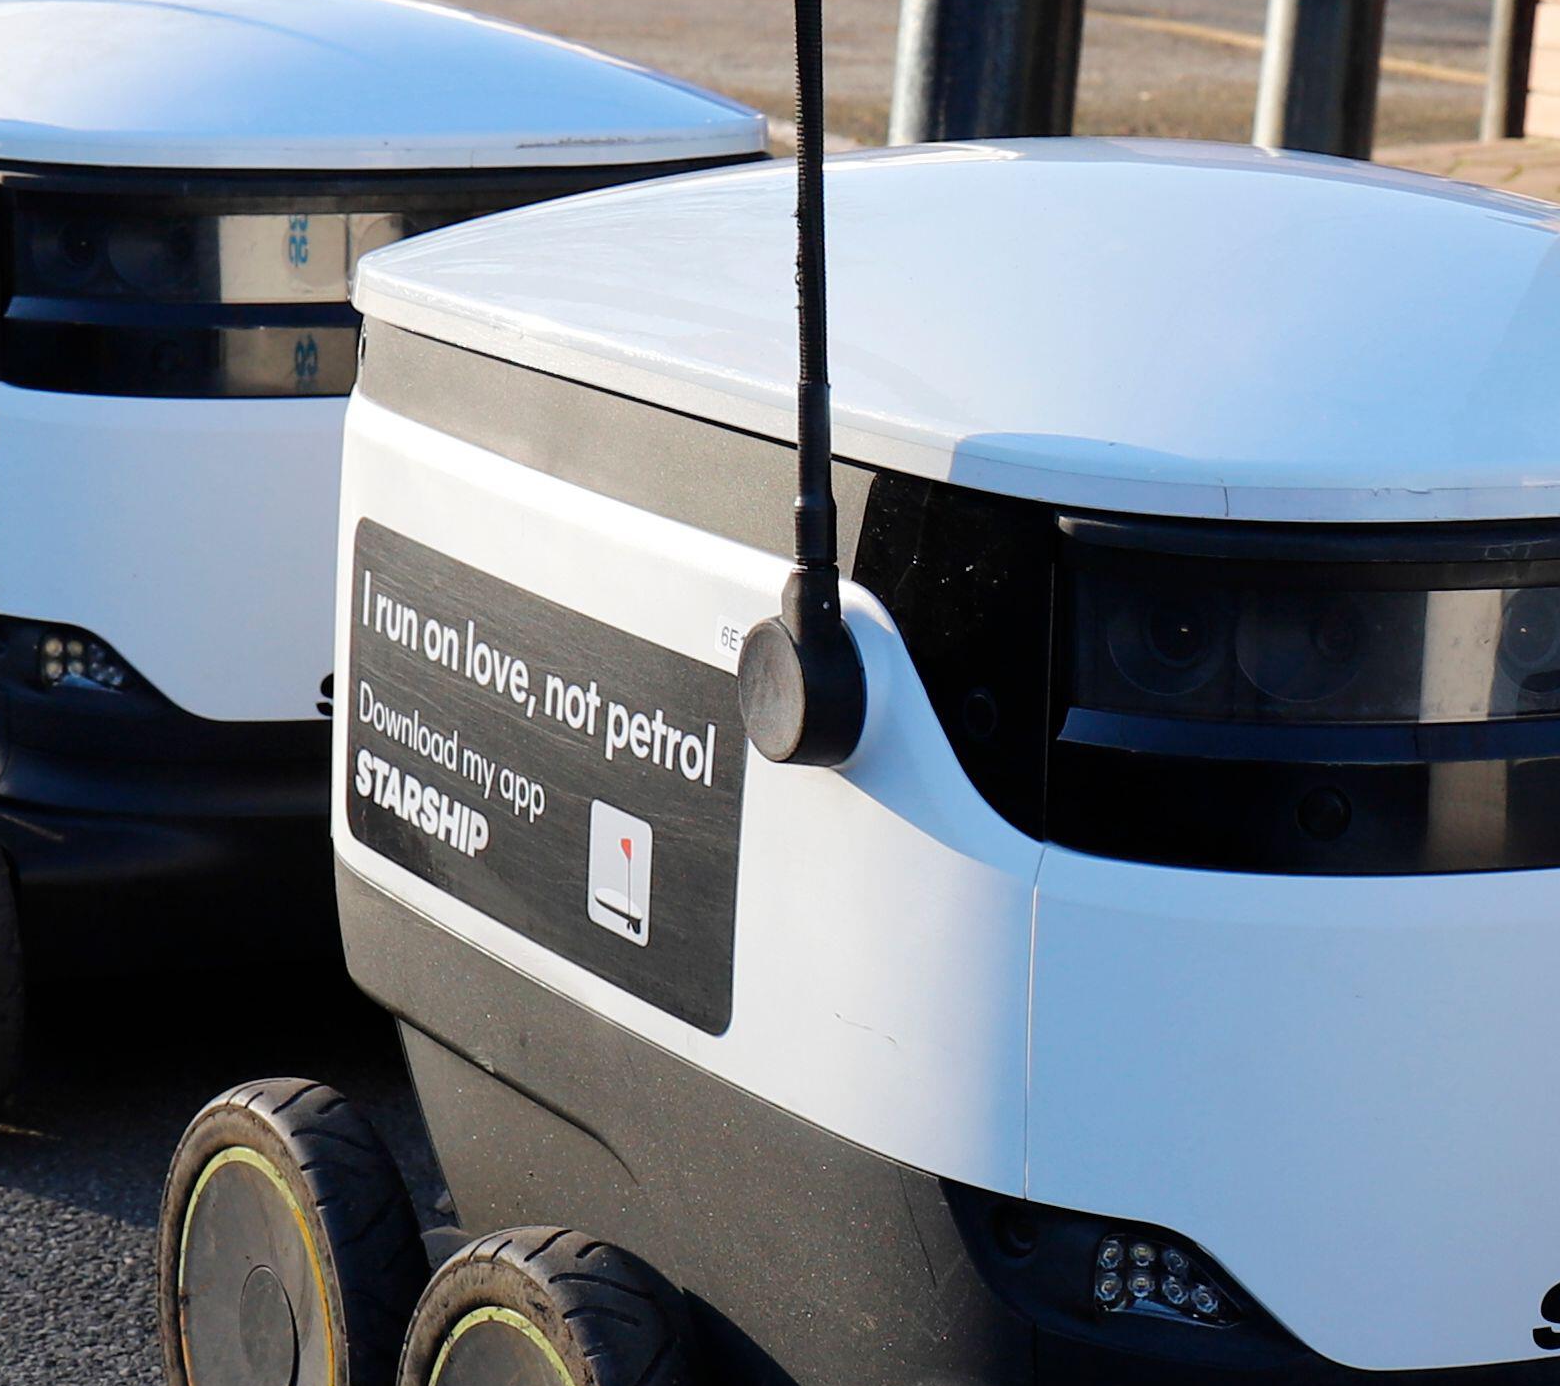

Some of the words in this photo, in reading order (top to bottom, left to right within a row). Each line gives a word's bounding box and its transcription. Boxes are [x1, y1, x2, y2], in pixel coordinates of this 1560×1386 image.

[363, 570, 372, 627] I
[376, 592, 419, 651] run
[424, 618, 459, 672] on
[466, 620, 537, 719] love,
[544, 673, 601, 736] not
[604, 700, 717, 788] petrol
[354, 749, 490, 858] STARSHIP
[359, 681, 458, 772] Download
[462, 747, 496, 801] my
[499, 764, 546, 823] app
